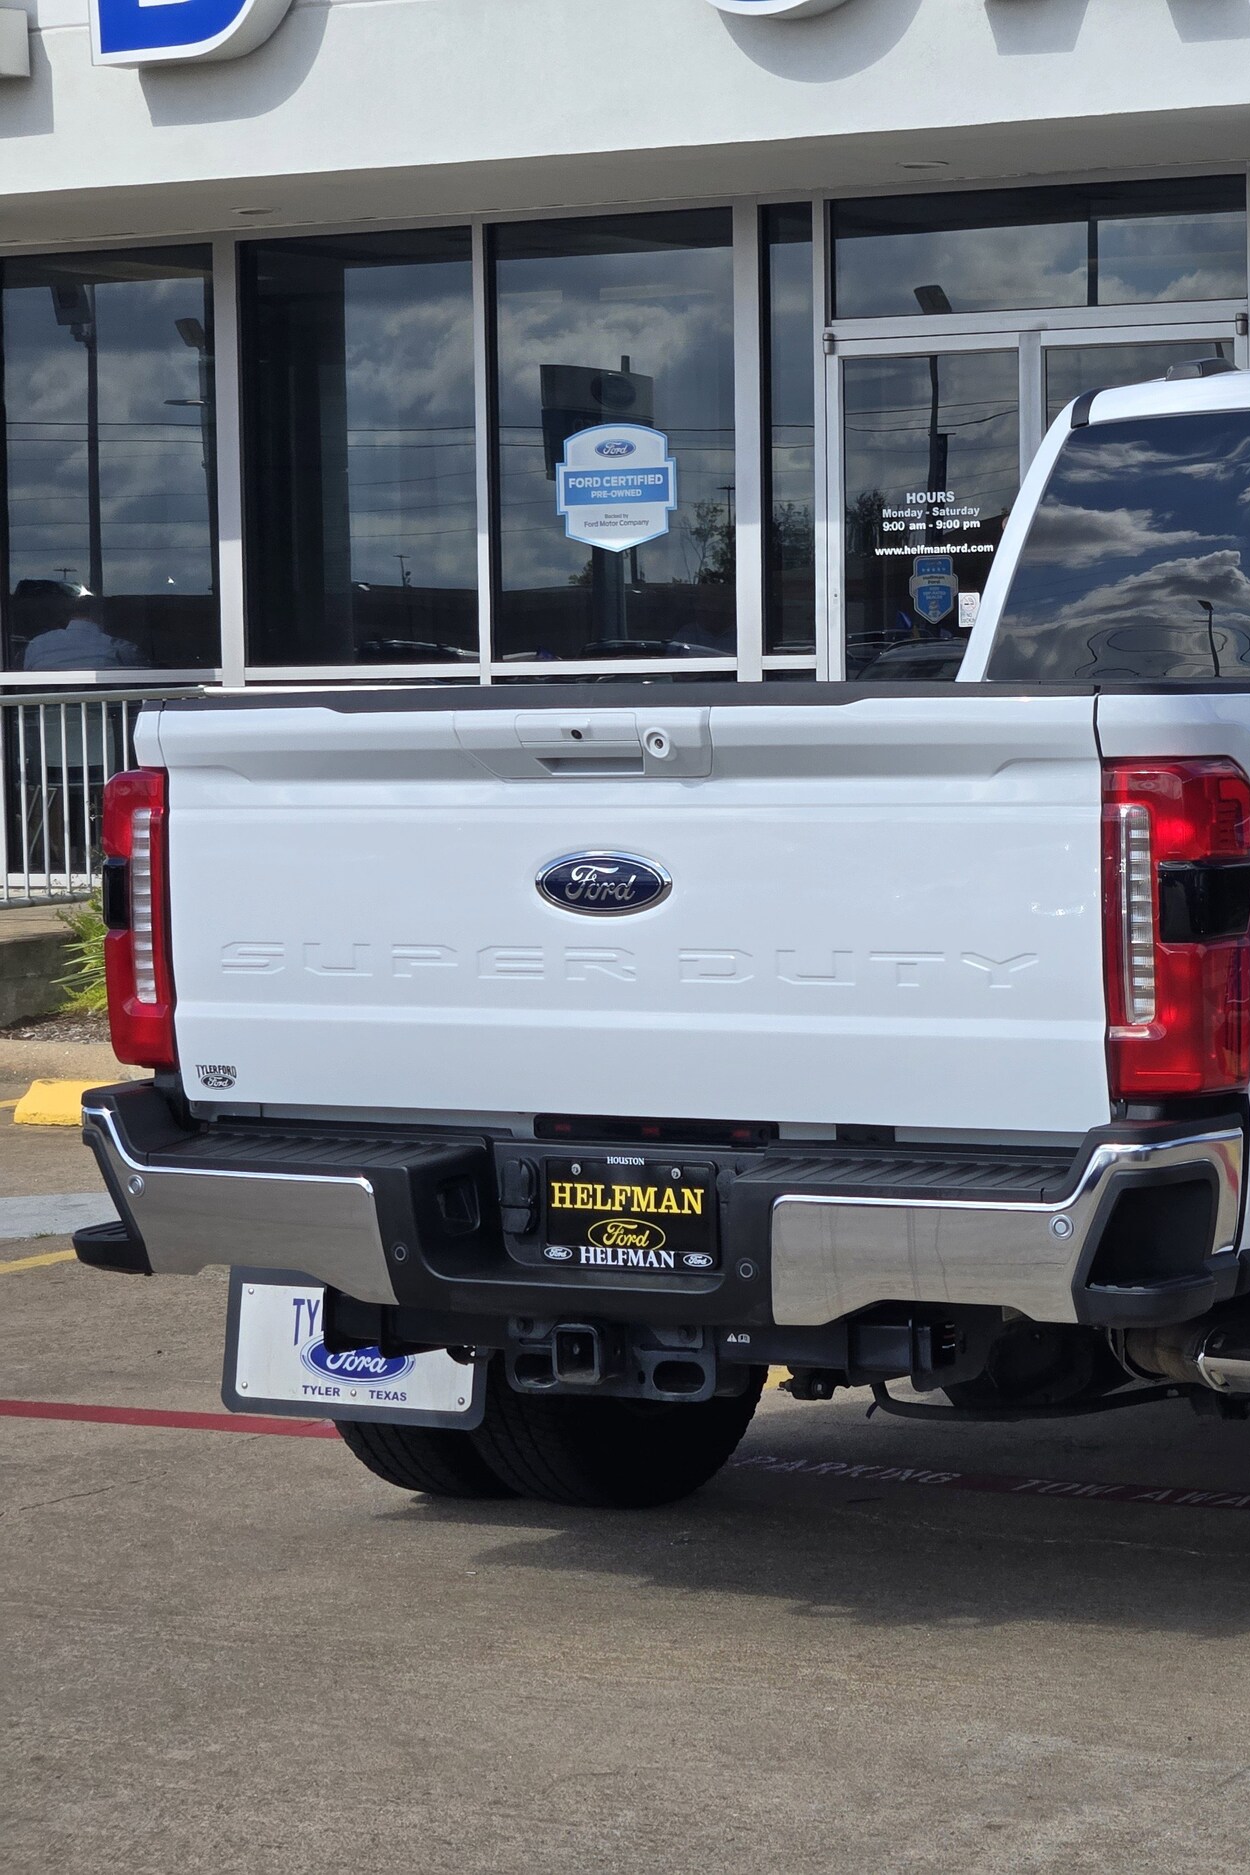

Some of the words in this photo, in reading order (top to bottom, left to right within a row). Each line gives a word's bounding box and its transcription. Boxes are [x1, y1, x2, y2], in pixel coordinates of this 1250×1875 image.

[602, 442, 628, 455] Ford
[568, 478, 601, 489] FORD
[602, 474, 664, 487] CERTIFIED
[591, 489, 642, 498] PRE-OWNED
[906, 491, 955, 504] HOURS
[882, 508, 923, 519] Monday
[932, 506, 980, 517] Saturday
[619, 519, 649, 527] Company
[882, 521, 906, 532] 9:00
[909, 522, 926, 530] am
[936, 519, 960, 530] 9:00
[963, 520, 980, 530] pm
[875, 543, 994, 556] www.helfmanford.com
[564, 864, 636, 901] Ford
[221, 941, 637, 982] SUPER
[678, 948, 1040, 988] DUTY
[208, 1076, 229, 1087] Ford
[606, 1156, 645, 1166] HOUSTON
[551, 1182, 705, 1215] HELFMAN
[602, 1222, 650, 1247] Ford
[549, 1248, 568, 1258] Ford
[579, 1246, 675, 1268] HELFMAN
[688, 1255, 708, 1266] Ford
[302, 1385, 341, 1397] TYLER
[369, 1389, 407, 1401] TEXAS
[733, 1456, 963, 1484] PARKING
[1011, 1479, 1126, 1496] TOW
